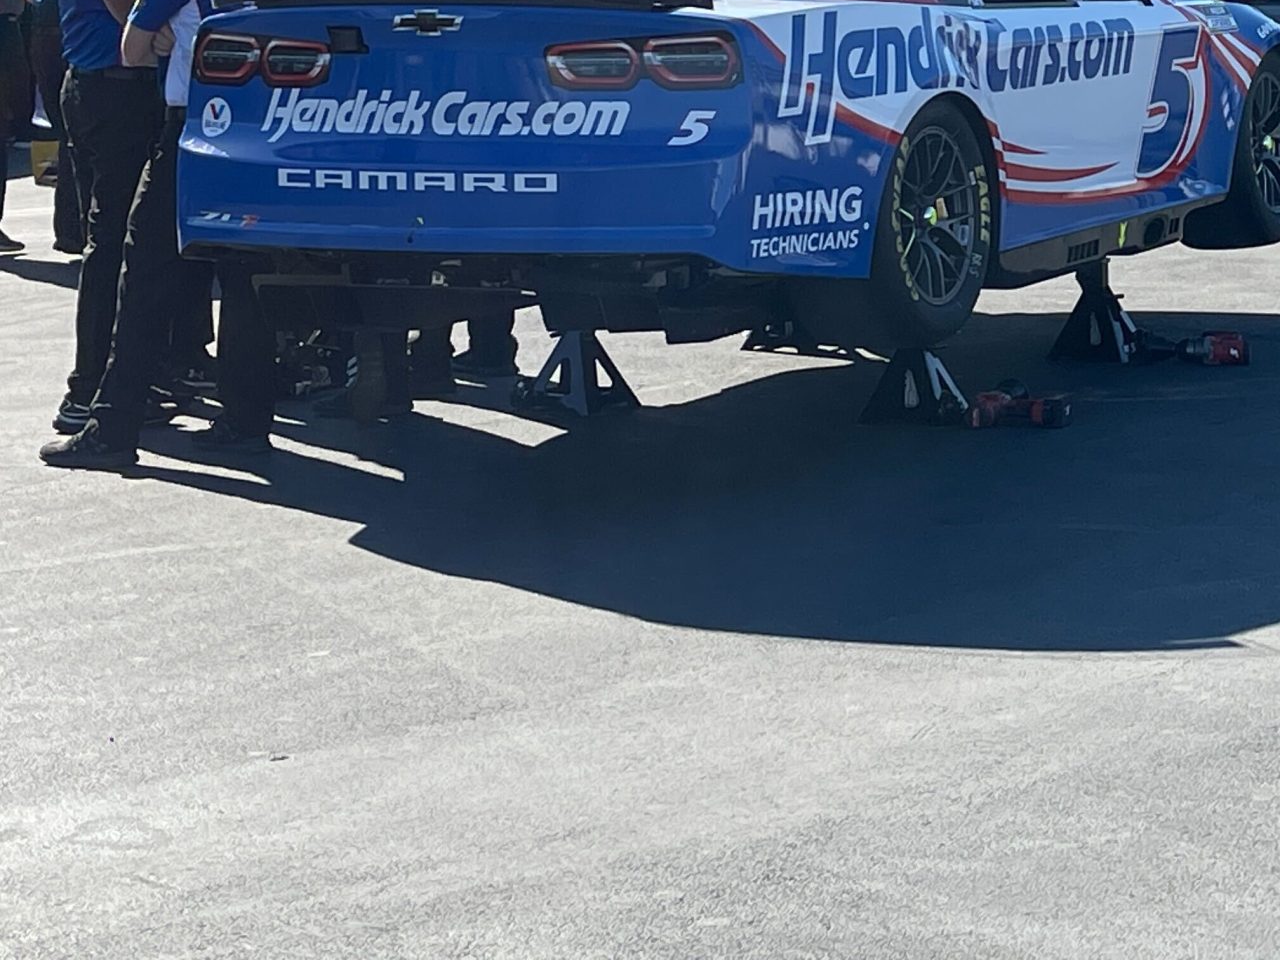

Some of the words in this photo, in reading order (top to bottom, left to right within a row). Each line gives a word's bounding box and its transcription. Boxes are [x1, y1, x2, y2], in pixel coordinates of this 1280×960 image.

[777, 6, 1135, 146] HendrickCars.com
[1134, 21, 1208, 180] 5
[260, 88, 630, 142] HendrickCars.com
[667, 110, 717, 146] 5
[277, 168, 558, 192] CAMARO
[974, 164, 990, 245] EAGLE
[752, 186, 864, 230] HIRING
[750, 229, 859, 259] TECHNICIANS
